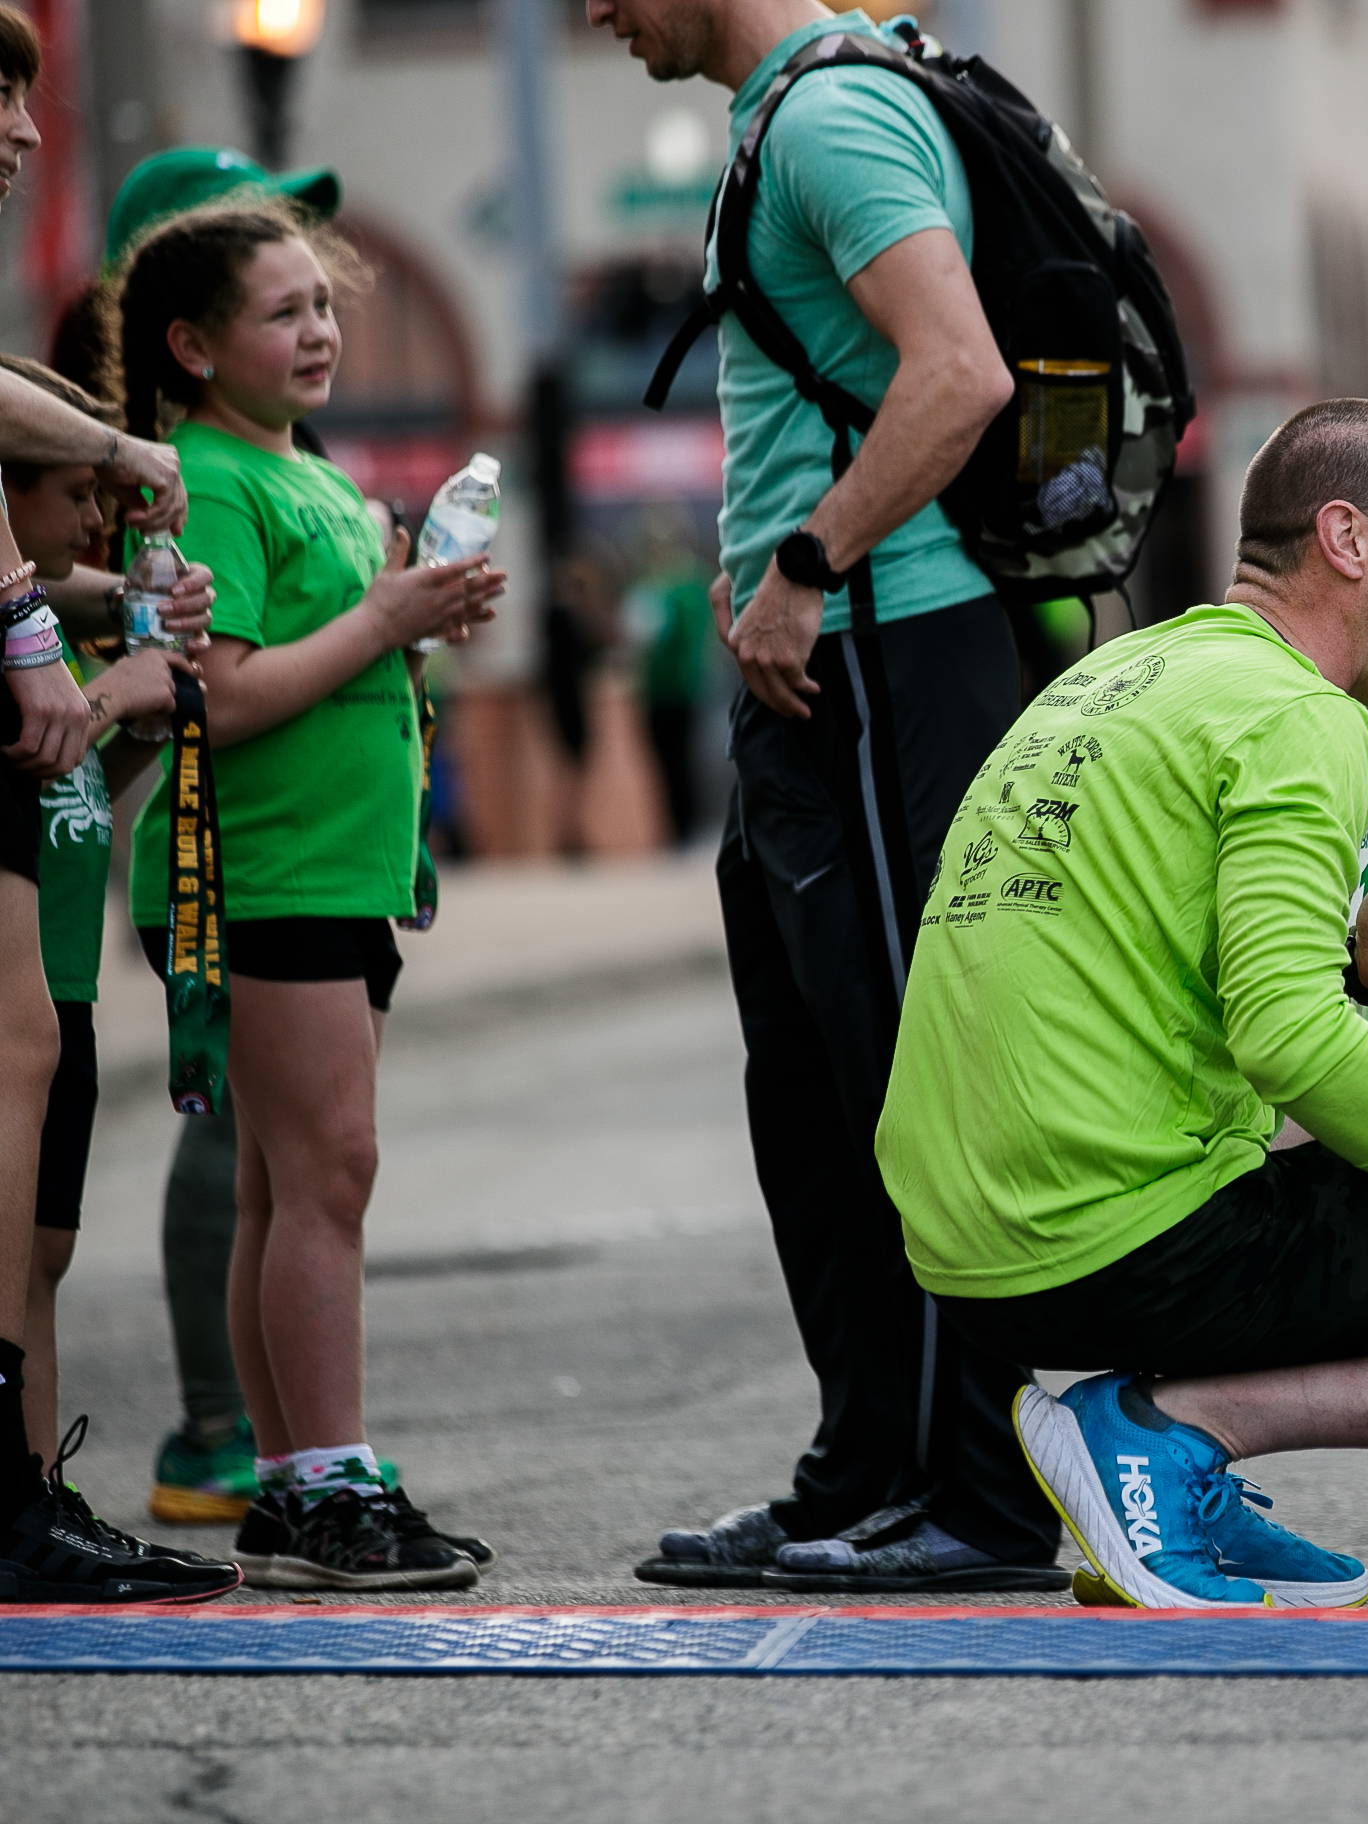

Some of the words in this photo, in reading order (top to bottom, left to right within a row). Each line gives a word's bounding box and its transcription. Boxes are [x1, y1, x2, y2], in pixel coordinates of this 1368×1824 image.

[1131, 660, 1162, 698] RUNNER
[1104, 702, 1120, 712] MI
[183, 720, 202, 739] 4
[1057, 734, 1087, 757] WHITE
[1083, 736, 1103, 762] HORSE
[178, 745, 200, 811] MILE
[1051, 771, 1081, 787] TAVERN
[176, 815, 199, 870] RUN
[1047, 842, 1071, 854] SERVICE
[177, 876, 200, 895] &
[963, 868, 988, 891] grocery
[1004, 879, 1063, 901] APTC
[946, 911, 966, 924] Haney
[964, 910, 987, 924] Agency
[174, 901, 200, 976] WALK
[1116, 1454, 1163, 1560] HOKA
